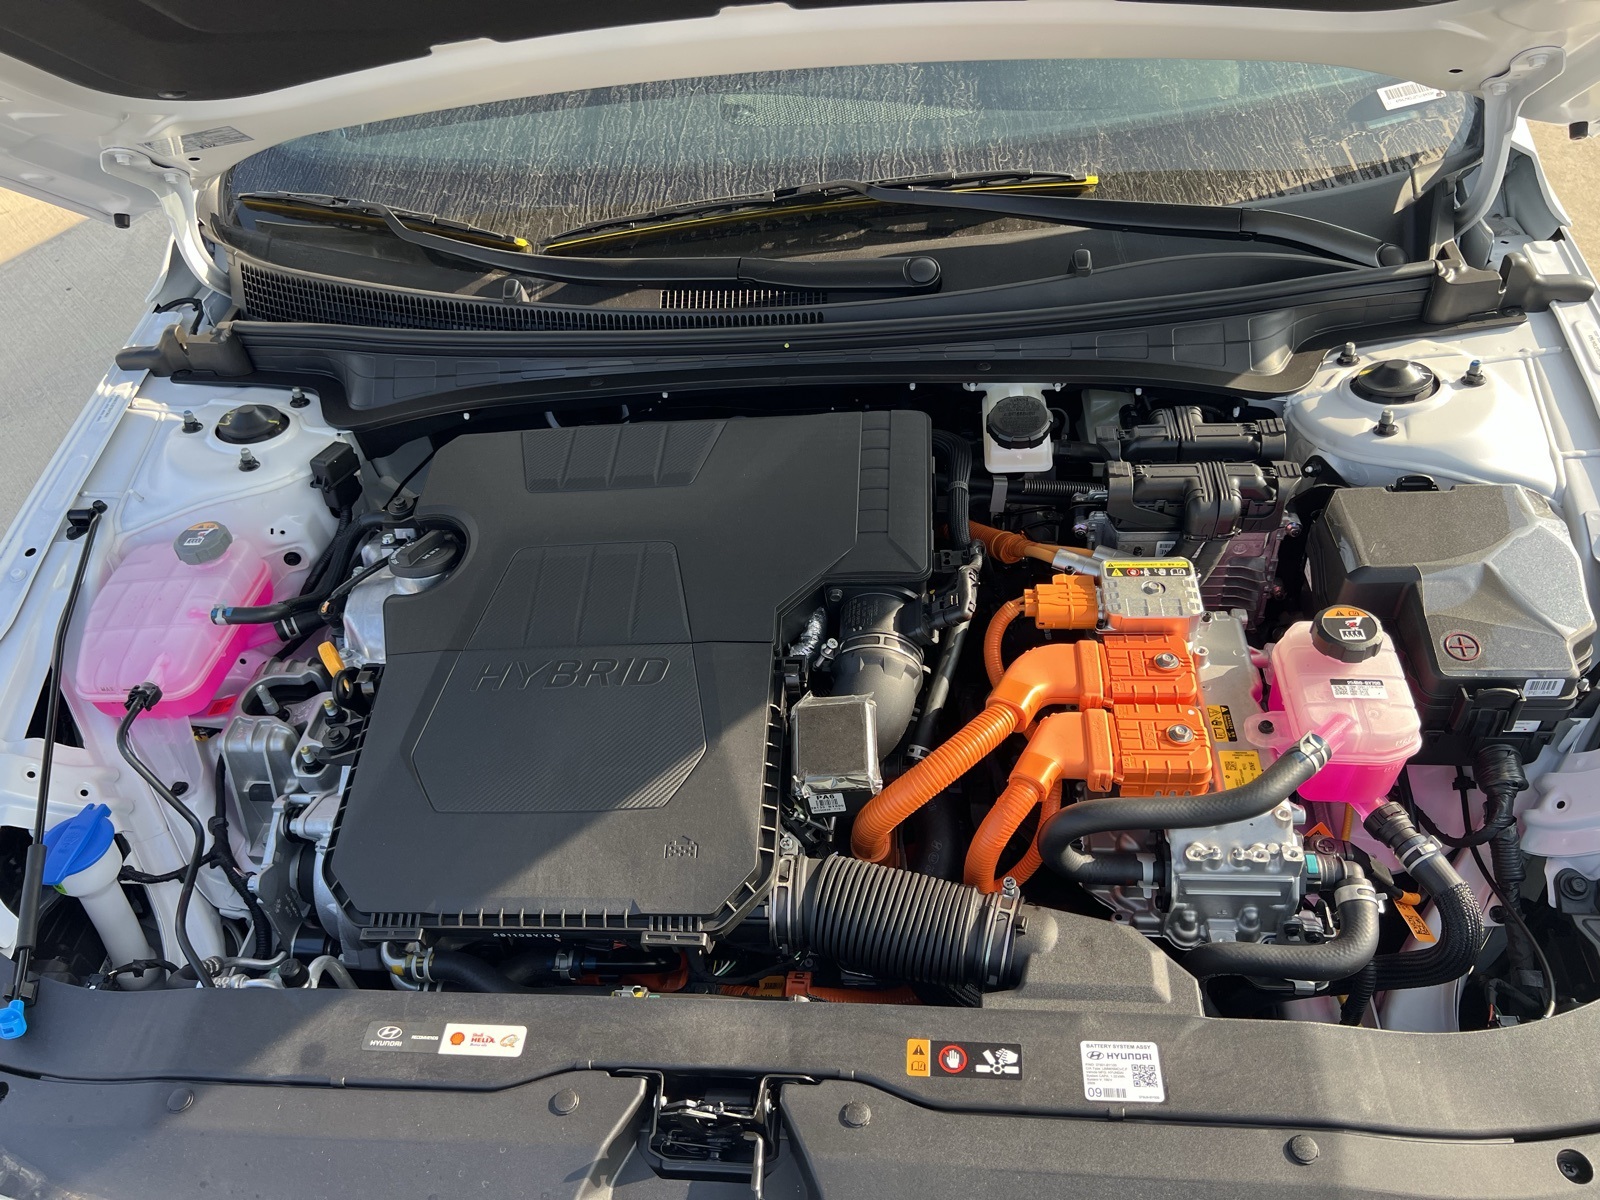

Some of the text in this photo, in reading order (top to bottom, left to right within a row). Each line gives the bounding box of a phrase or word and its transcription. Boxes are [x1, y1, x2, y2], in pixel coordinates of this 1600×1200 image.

[470, 656, 671, 692] HYBRID
[1107, 1052, 1152, 1060] HYUNDAI
[1088, 1087, 1102, 1097] 09
